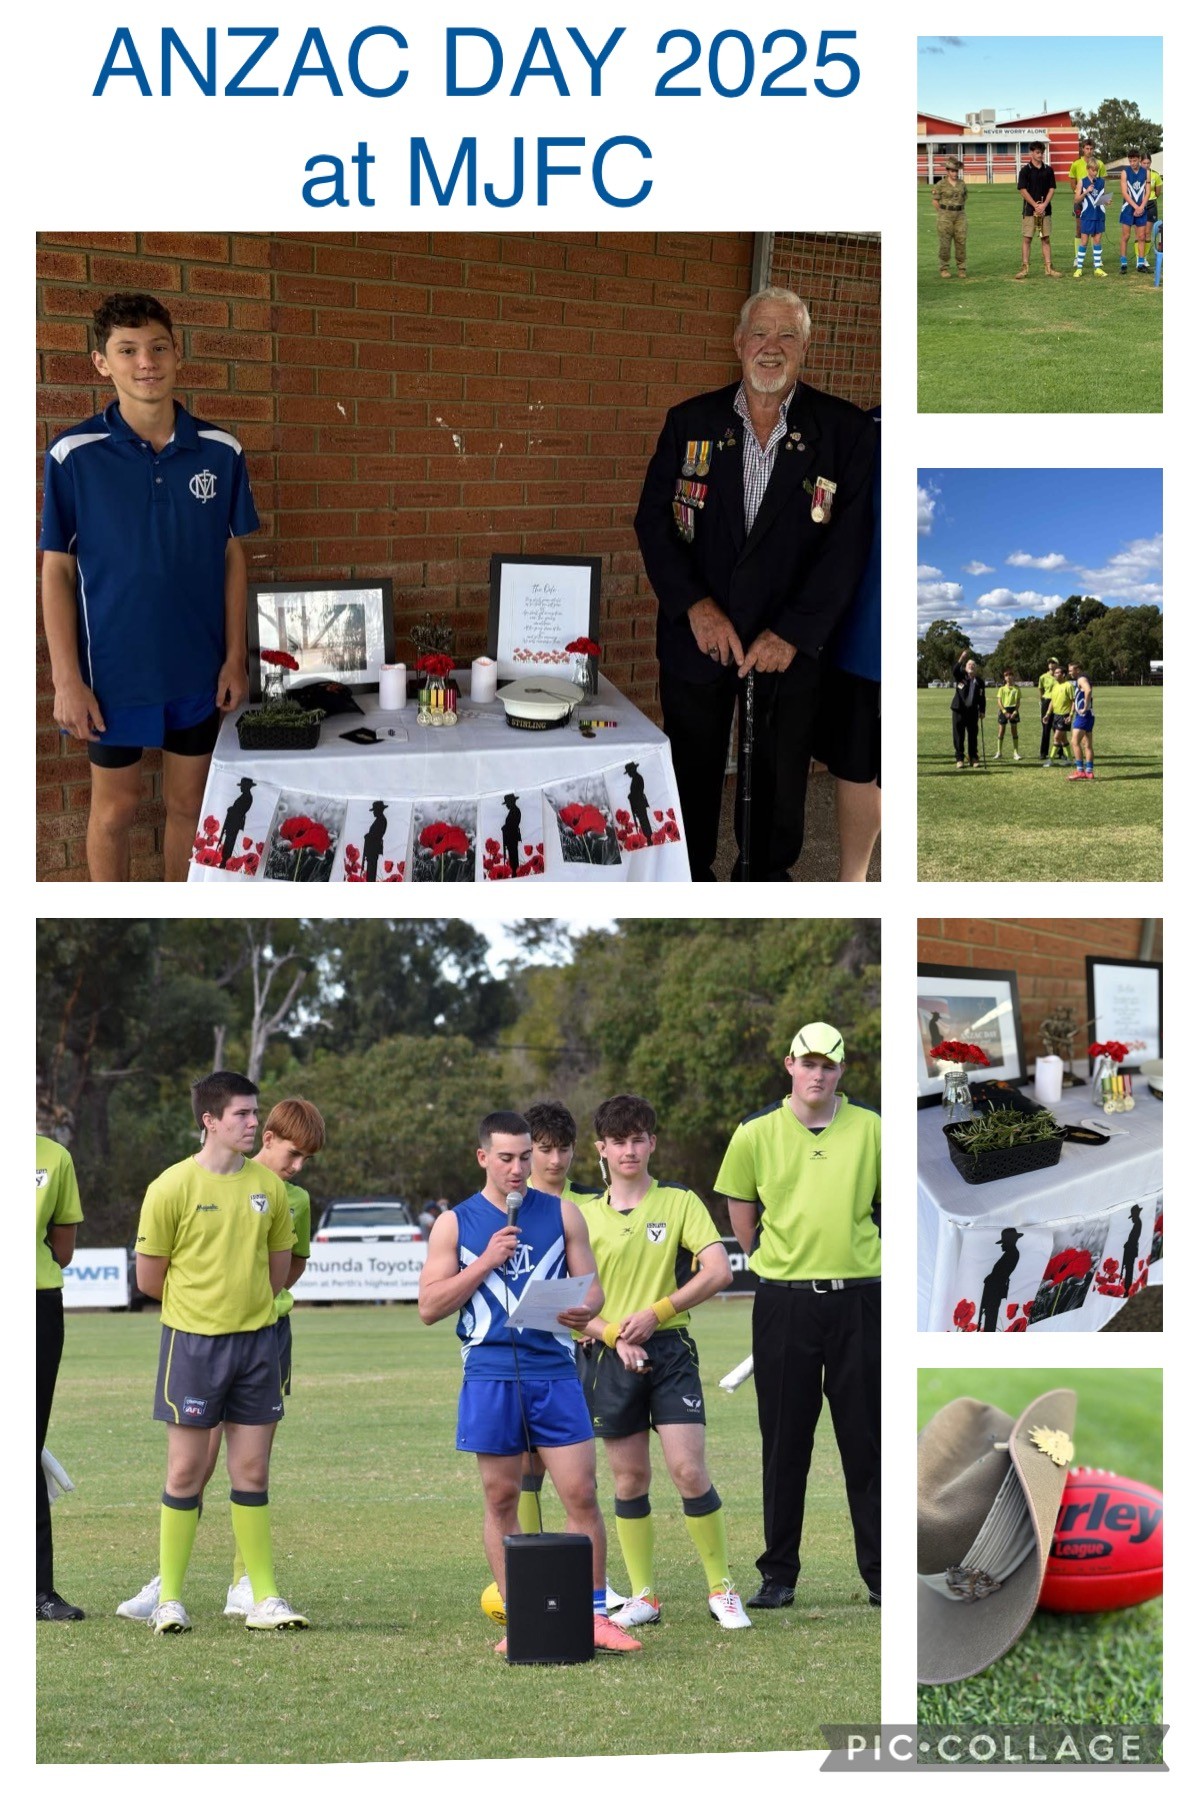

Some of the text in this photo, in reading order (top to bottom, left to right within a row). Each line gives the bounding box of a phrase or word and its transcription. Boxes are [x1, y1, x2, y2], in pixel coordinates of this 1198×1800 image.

[511, 718, 546, 729] STIRLING
[367, 1258, 423, 1276] Toyota
[1056, 1543, 1104, 1558] League
